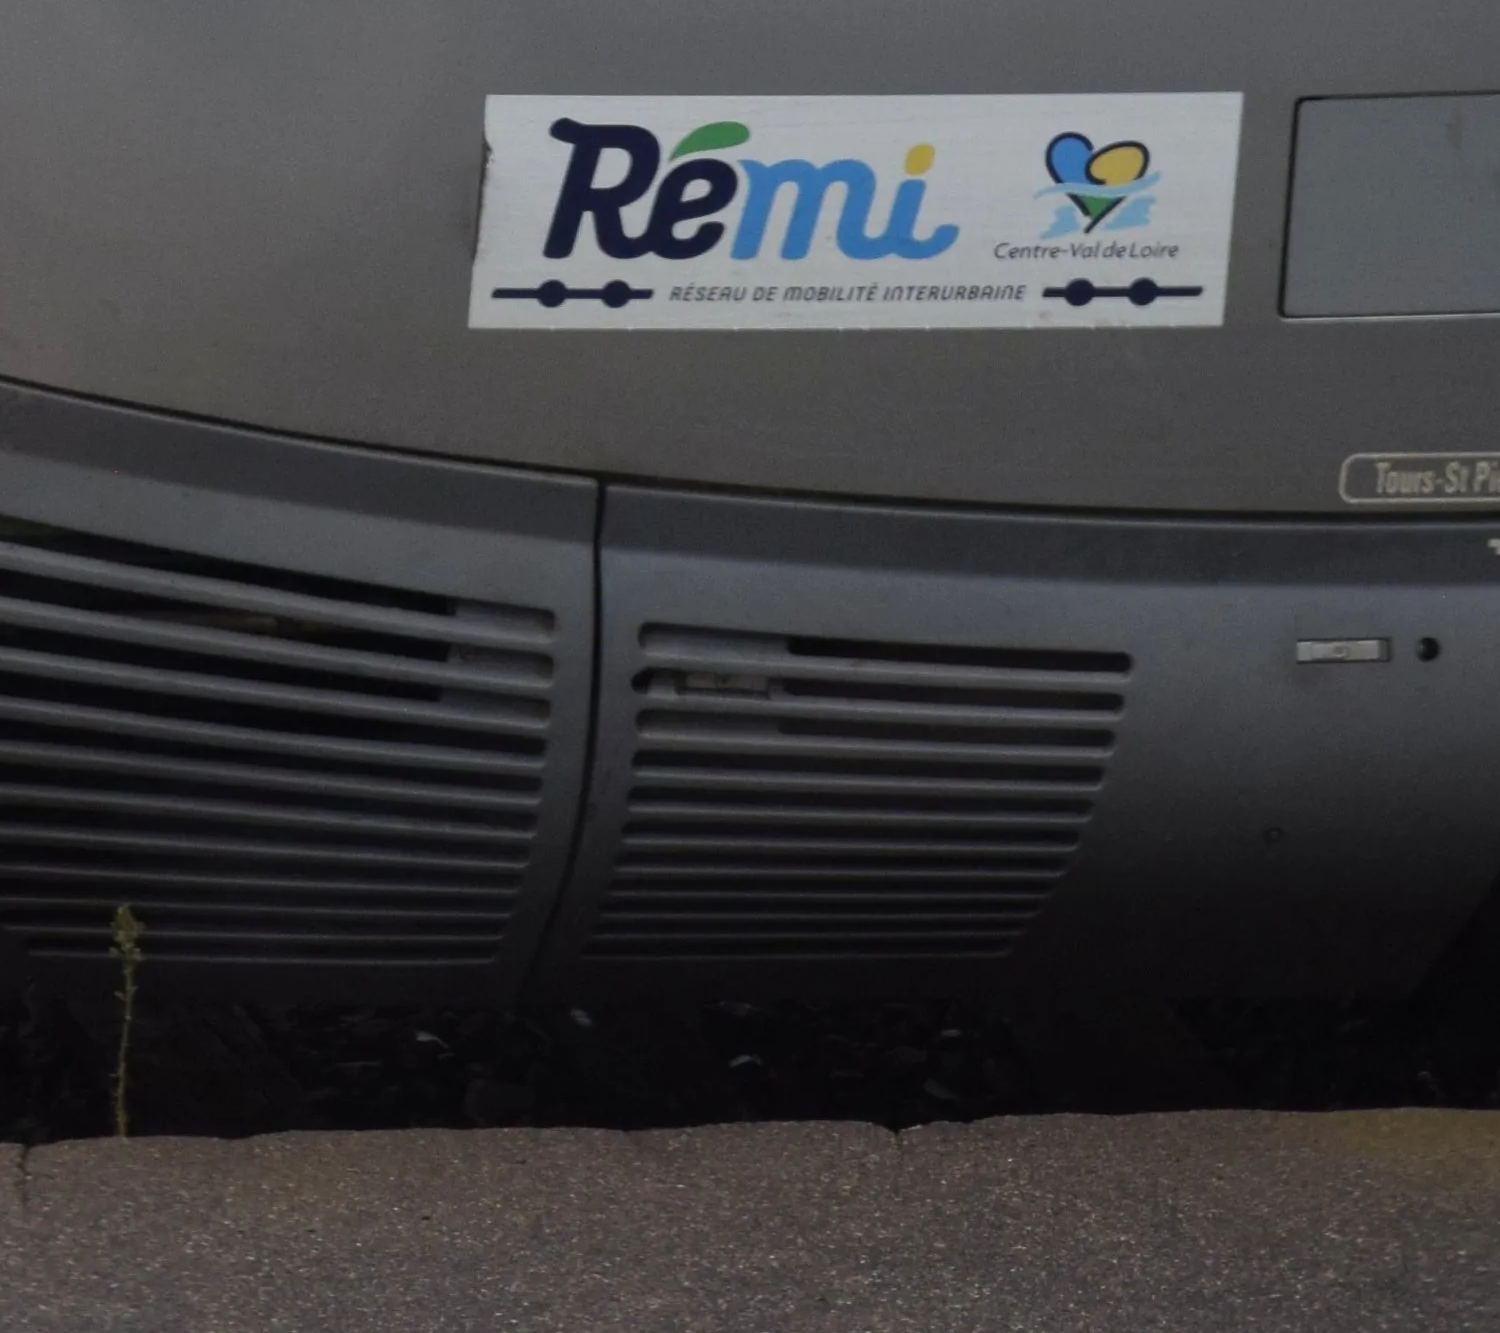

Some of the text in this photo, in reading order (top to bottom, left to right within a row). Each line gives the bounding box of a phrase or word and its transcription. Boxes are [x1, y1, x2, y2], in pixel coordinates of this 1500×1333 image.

[542, 117, 960, 260] Rémi
[993, 241, 1180, 260] Centre-Val de Loire
[669, 282, 1028, 302] RÉSEAU DE MOBILITÉ INTERURBAINE
[1374, 461, 1469, 495] Tours-St
